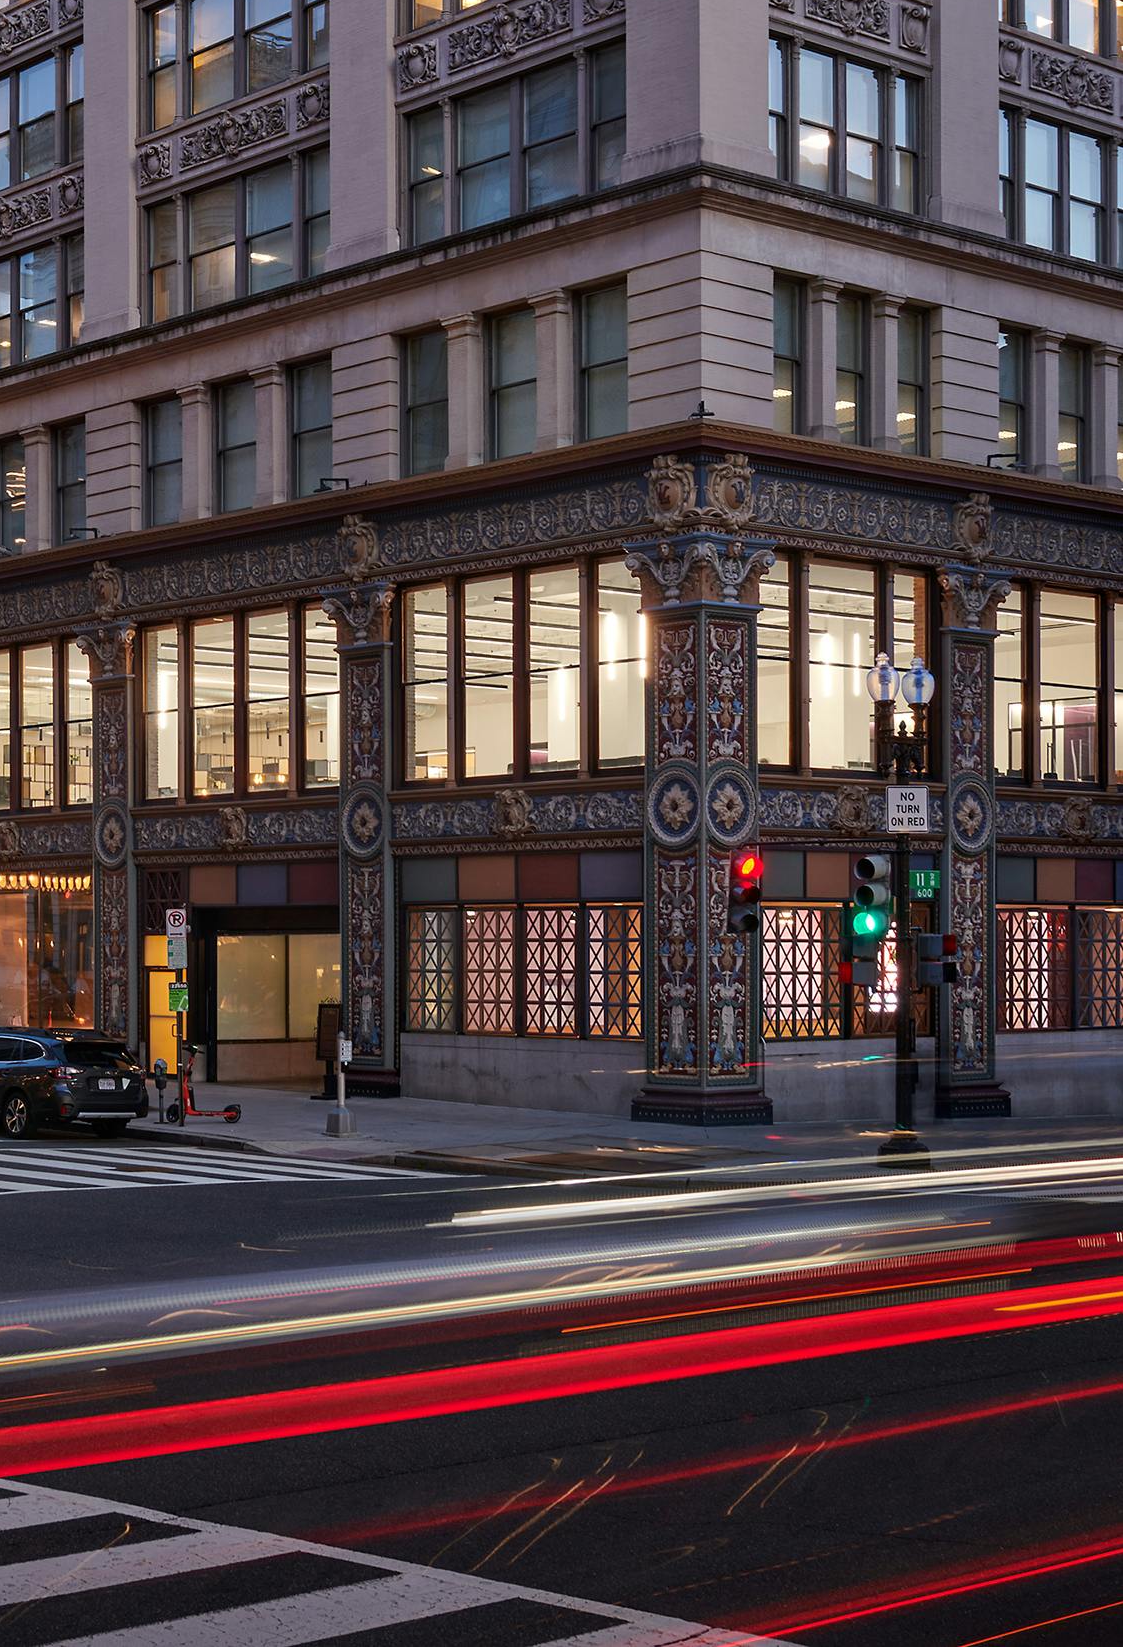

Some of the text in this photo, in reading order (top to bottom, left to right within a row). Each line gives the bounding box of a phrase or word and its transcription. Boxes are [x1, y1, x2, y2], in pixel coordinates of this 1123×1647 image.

[900, 792, 915, 802] NO
[896, 804, 920, 814] TURN
[891, 817, 925, 827] ON RED
[916, 872, 925, 886] 11
[917, 888, 933, 898] 600
